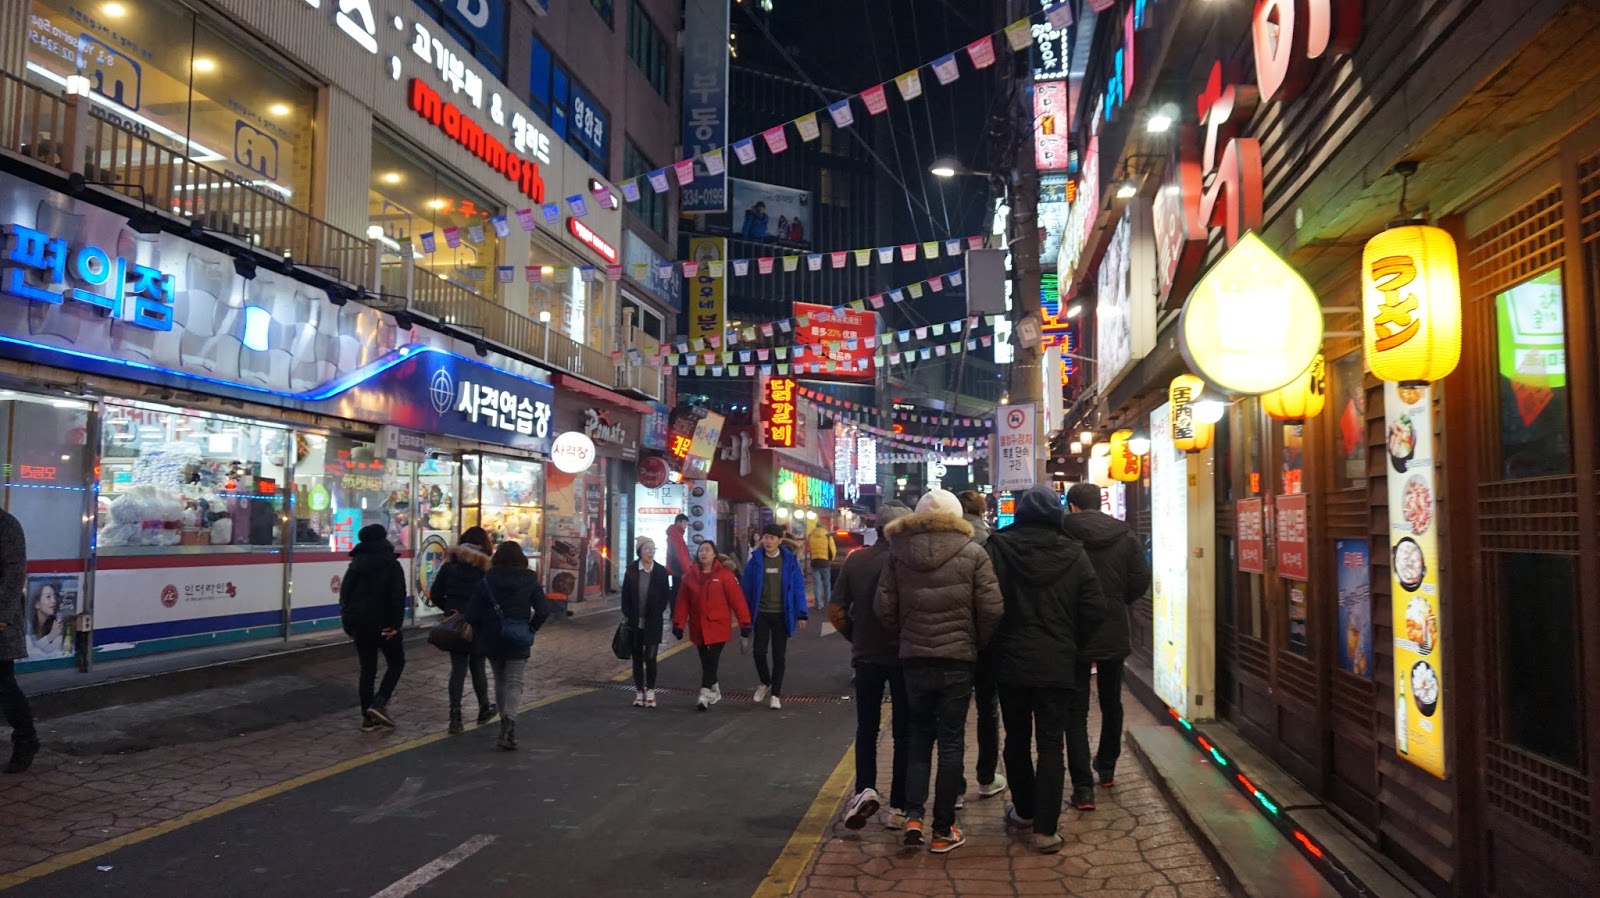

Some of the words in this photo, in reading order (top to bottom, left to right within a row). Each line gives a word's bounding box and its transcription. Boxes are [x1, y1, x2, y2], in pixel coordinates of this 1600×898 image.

[410, 77, 545, 205] mammoth
[4, 223, 175, 332] 편의점
[457, 380, 551, 438] 사격연습장
[770, 378, 796, 447] 닭갈비
[1008, 459, 1021, 471] 구간
